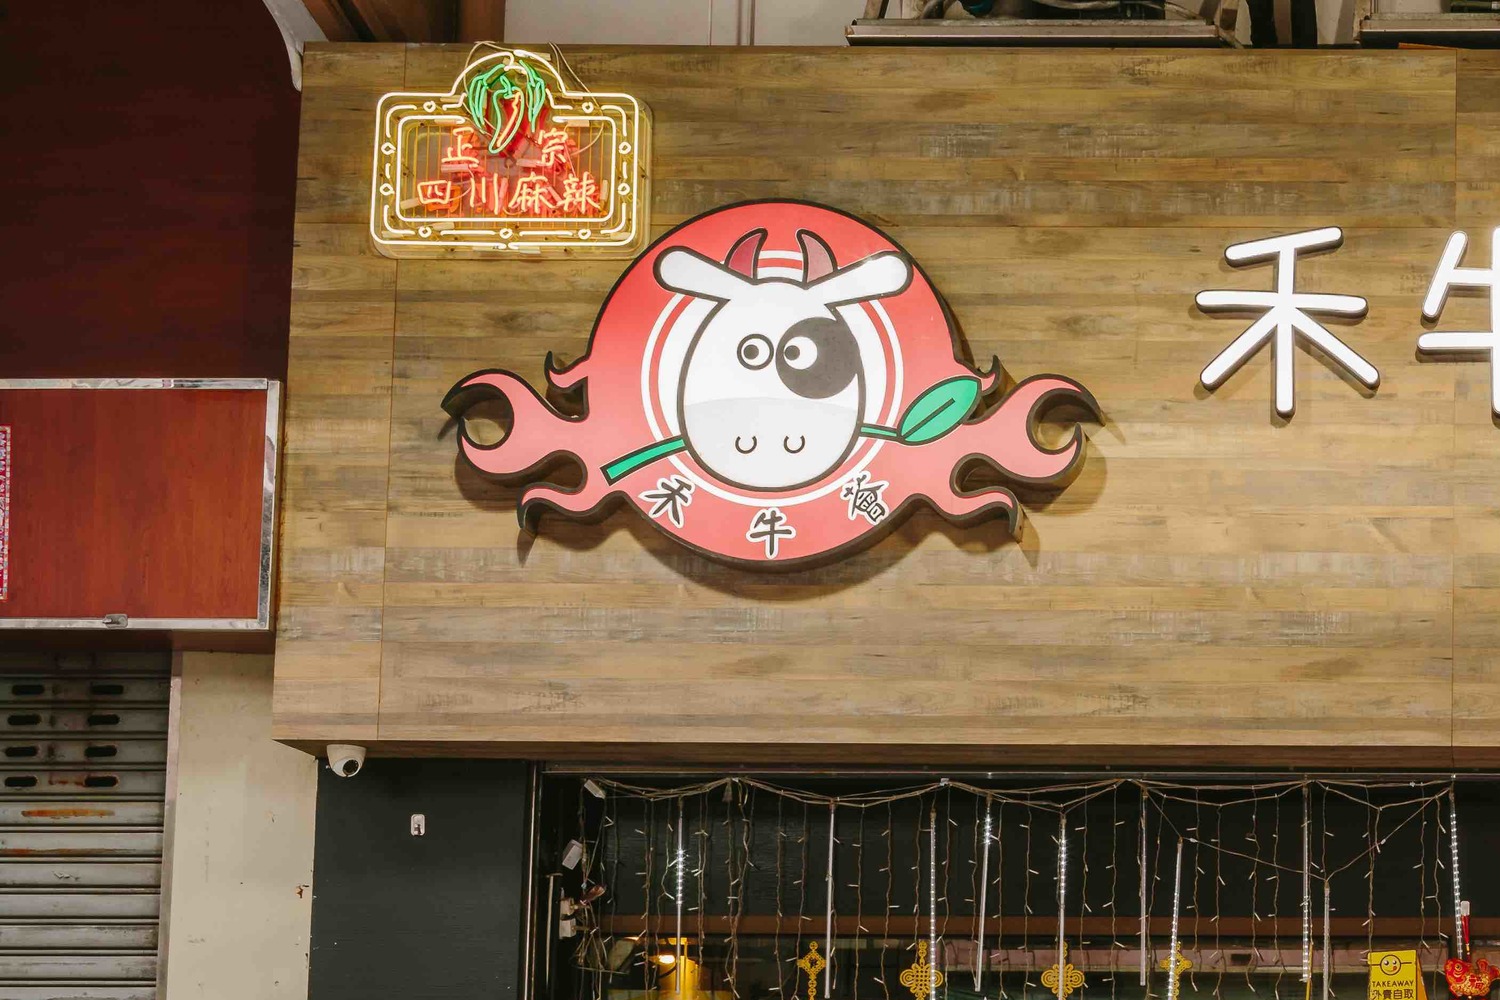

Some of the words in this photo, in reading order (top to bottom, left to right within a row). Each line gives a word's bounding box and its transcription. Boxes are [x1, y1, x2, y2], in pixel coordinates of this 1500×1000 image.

[416, 176, 601, 214] 四川麻辣
[1371, 989, 1414, 1000] 外賣自取
